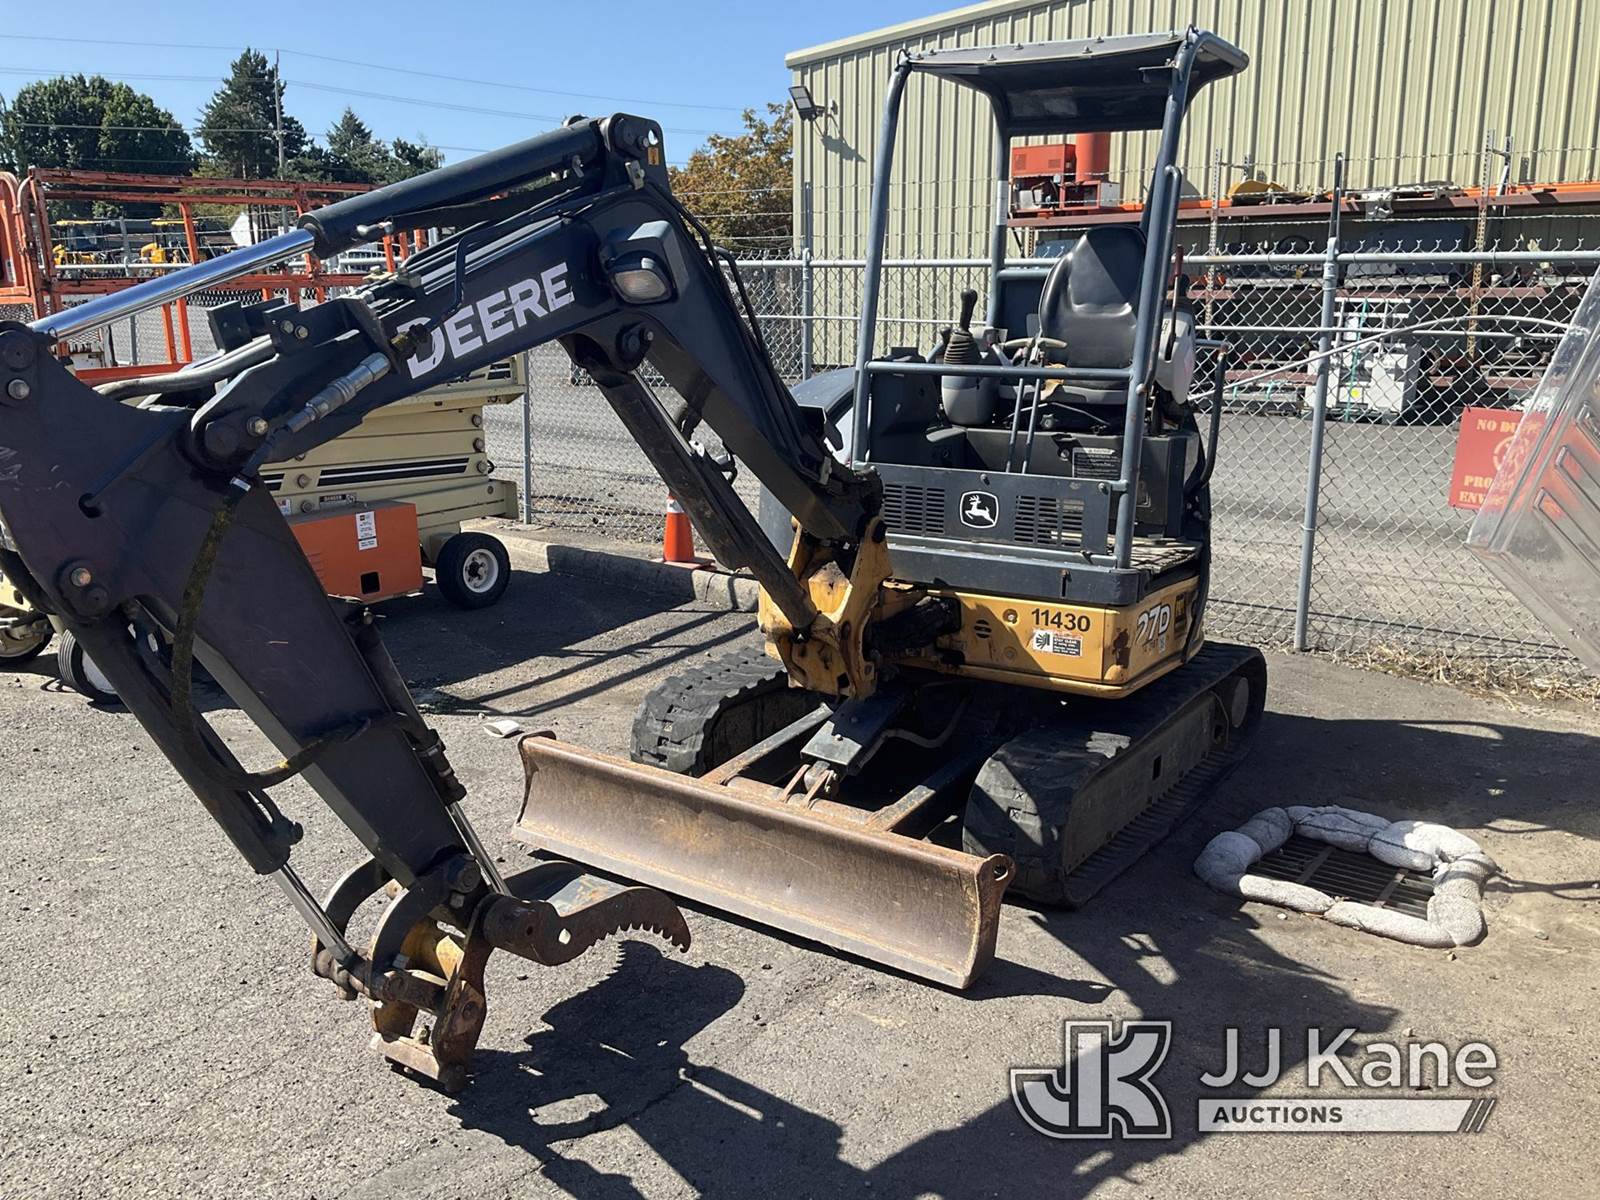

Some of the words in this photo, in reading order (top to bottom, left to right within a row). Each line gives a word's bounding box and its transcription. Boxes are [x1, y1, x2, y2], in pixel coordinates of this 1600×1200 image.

[396, 262, 576, 380] DEERE
[1476, 419, 1498, 432] NO
[1031, 608, 1091, 632] 11430
